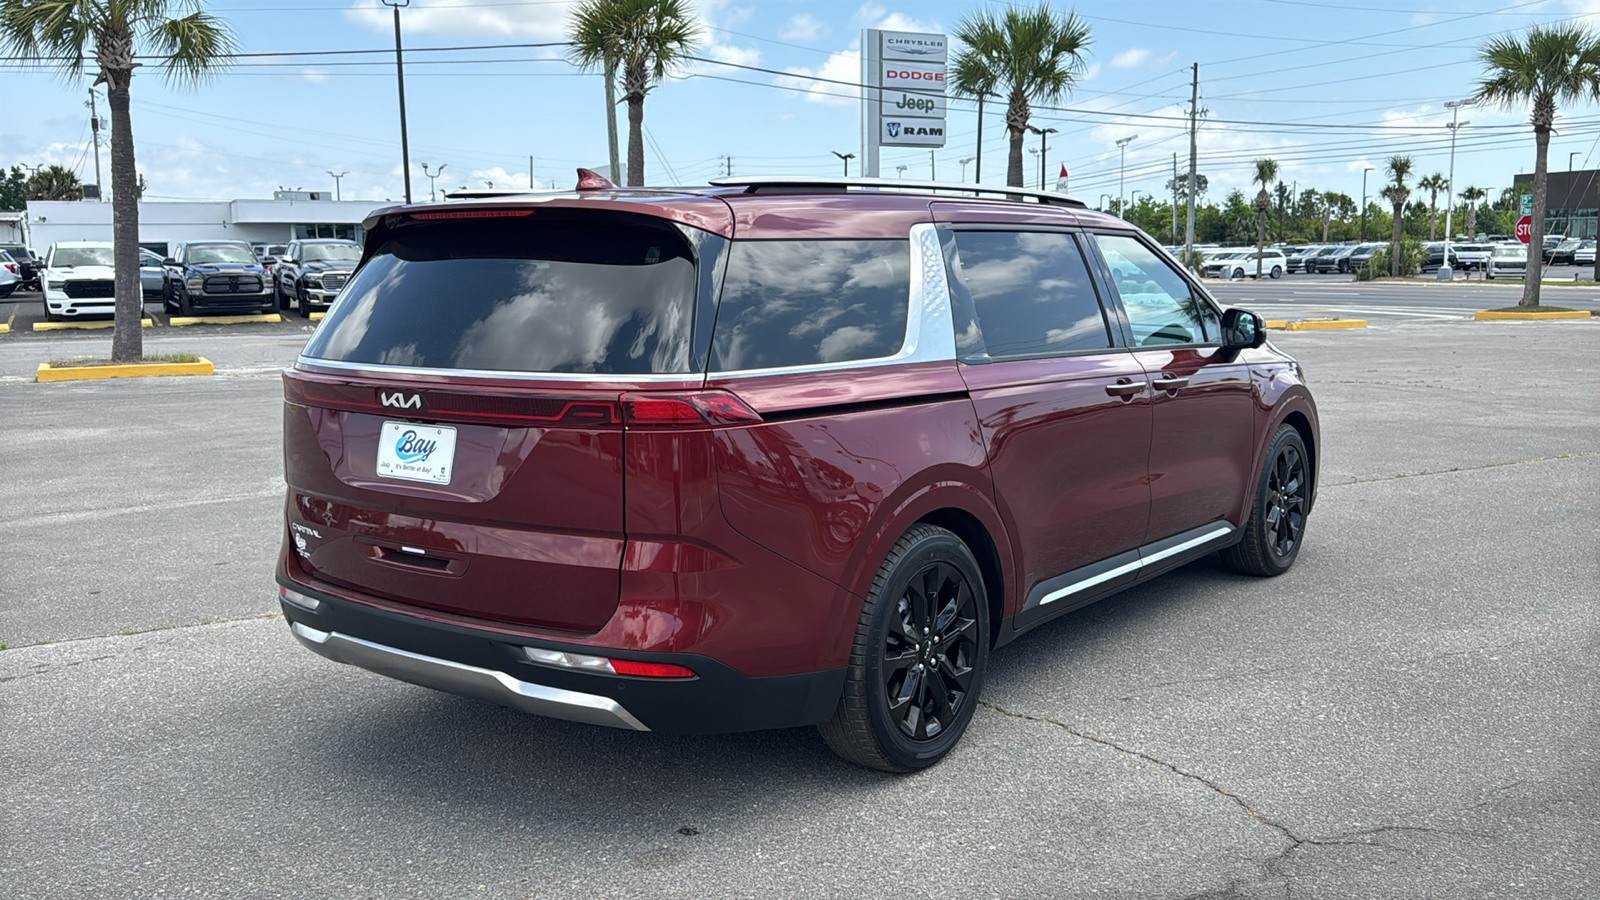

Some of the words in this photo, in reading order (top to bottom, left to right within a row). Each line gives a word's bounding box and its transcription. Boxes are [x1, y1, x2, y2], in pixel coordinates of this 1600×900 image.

[887, 38, 943, 47] CHRYSLER
[886, 70, 944, 81] DODGE
[896, 94, 935, 113] Jeep
[903, 127, 943, 136] RAM
[1517, 224, 1531, 236] STO
[381, 391, 421, 409] KIA
[399, 430, 437, 462] Bay
